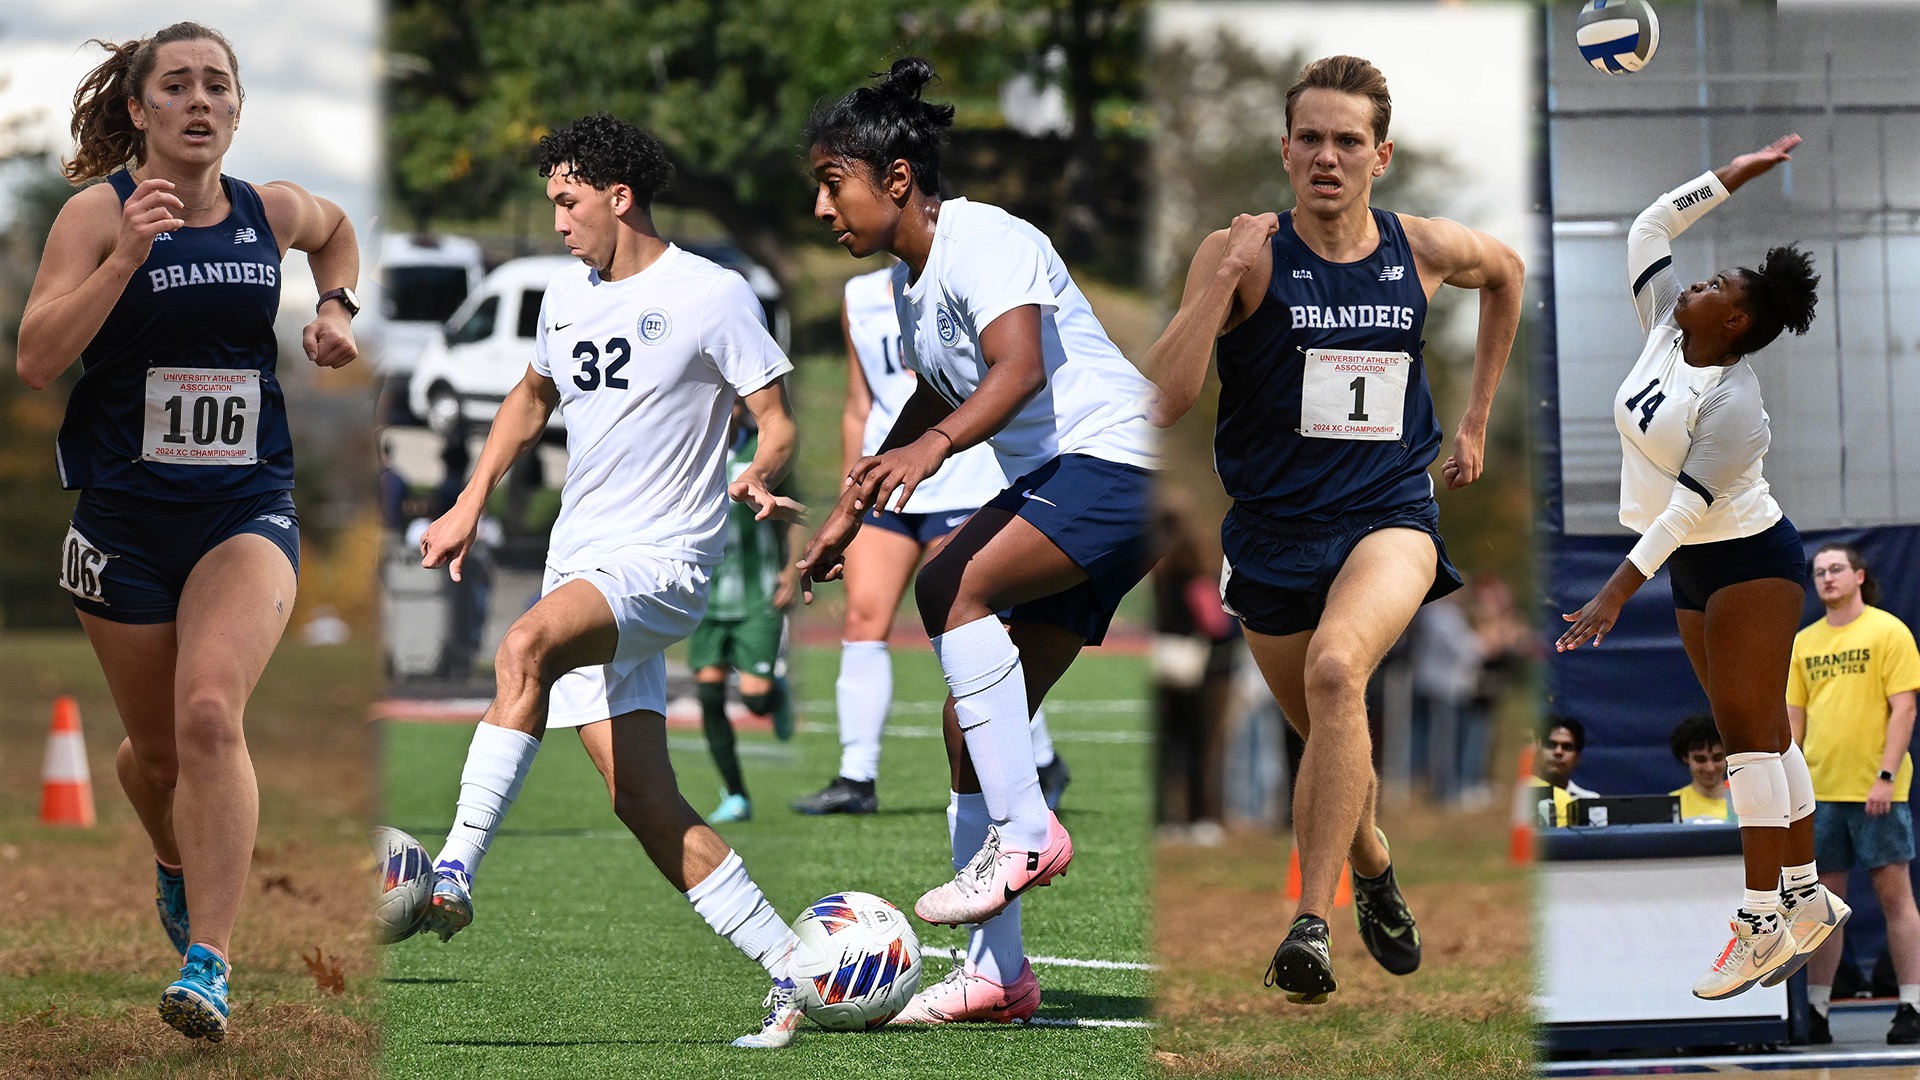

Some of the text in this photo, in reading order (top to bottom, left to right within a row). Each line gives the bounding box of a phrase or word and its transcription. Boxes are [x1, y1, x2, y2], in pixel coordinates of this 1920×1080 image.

[154, 232, 173, 241] AA
[148, 262, 276, 292] BRANDEIS
[1289, 304, 1414, 330] BRANDEIS
[572, 337, 631, 391] 32
[1320, 355, 1400, 364] UNIVERSITY ATHLETIC
[1335, 364, 1386, 373] ASSOCIATION
[163, 373, 211, 381] UNIVERSITY
[180, 383, 232, 392] ASSOCIATION
[1348, 376, 1369, 421] 1
[1624, 378, 1667, 434] 14
[162, 395, 247, 446] 106
[1312, 423, 1331, 431] 2024
[1344, 425, 1395, 433] CHAMPIONSHIP
[155, 447, 174, 456] 2024
[189, 449, 247, 457] CHAMPIONSHIP
[61, 537, 102, 597] 06
